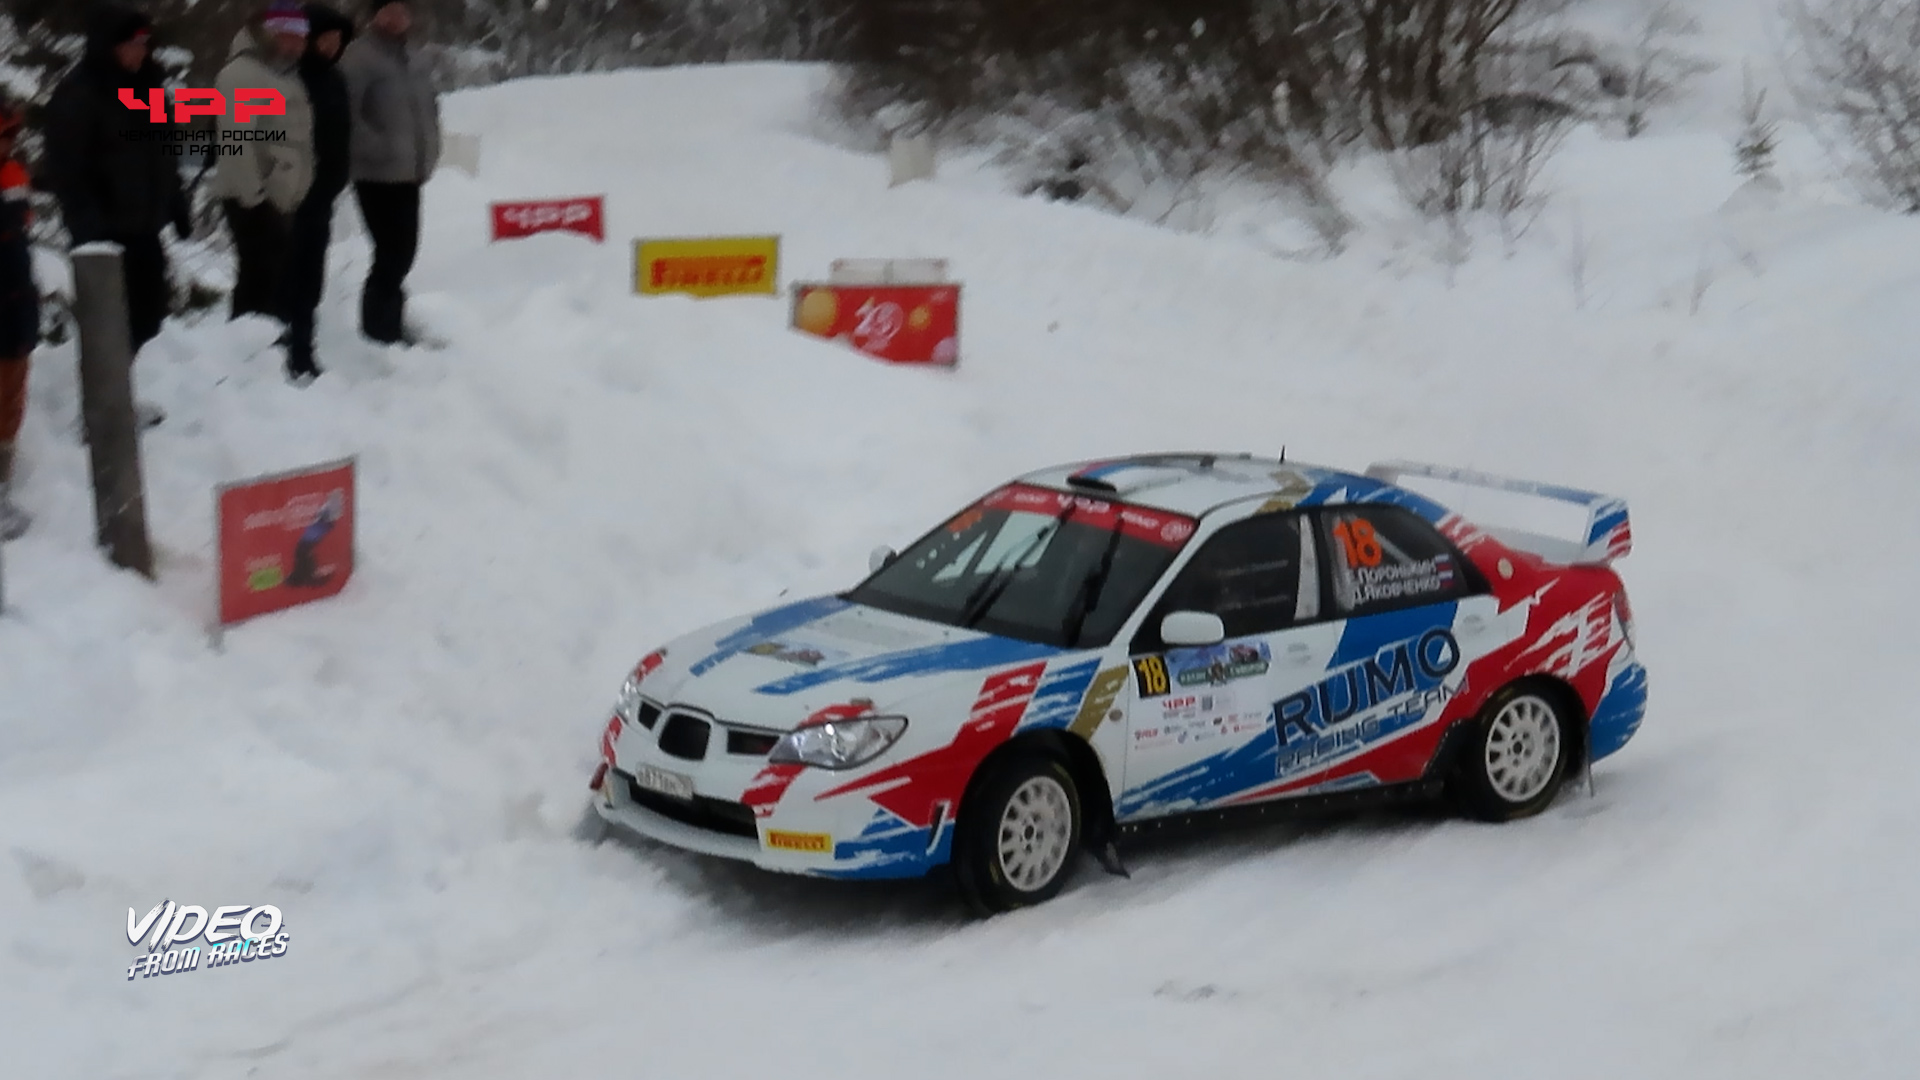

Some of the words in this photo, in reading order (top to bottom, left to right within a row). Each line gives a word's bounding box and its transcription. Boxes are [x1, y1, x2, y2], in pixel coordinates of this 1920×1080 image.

[1333, 518, 1382, 569] 18
[1137, 655, 1168, 694] 18
[1273, 626, 1461, 747] RUMO
[1387, 674, 1470, 723] TEAM
